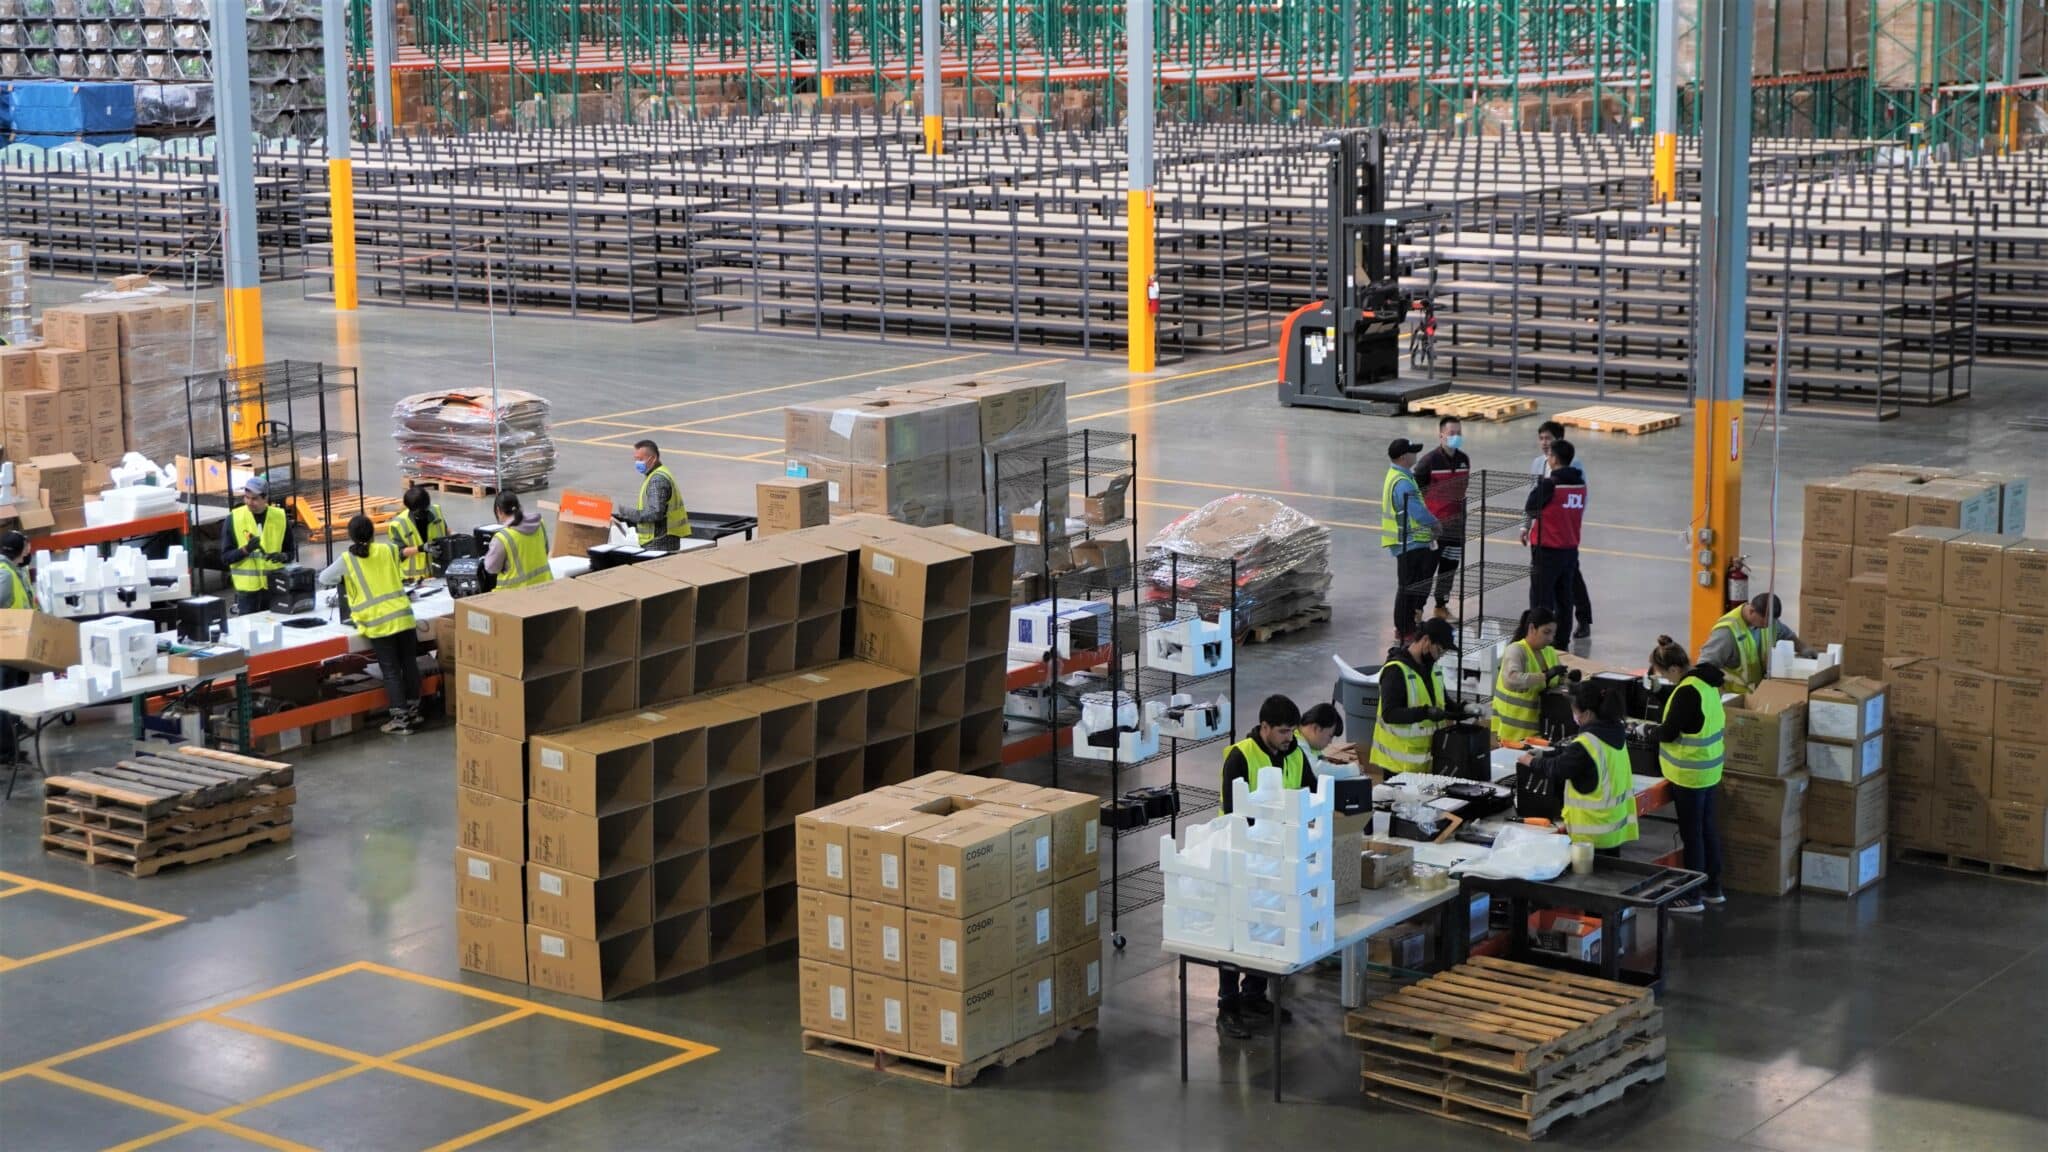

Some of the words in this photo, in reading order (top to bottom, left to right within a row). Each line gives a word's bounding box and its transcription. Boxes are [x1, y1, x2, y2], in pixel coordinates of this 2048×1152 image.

[1562, 493, 1584, 508] JDL
[967, 844, 994, 860] COSORI
[967, 916, 994, 935] COSORI
[967, 987, 994, 1006] COSORI
